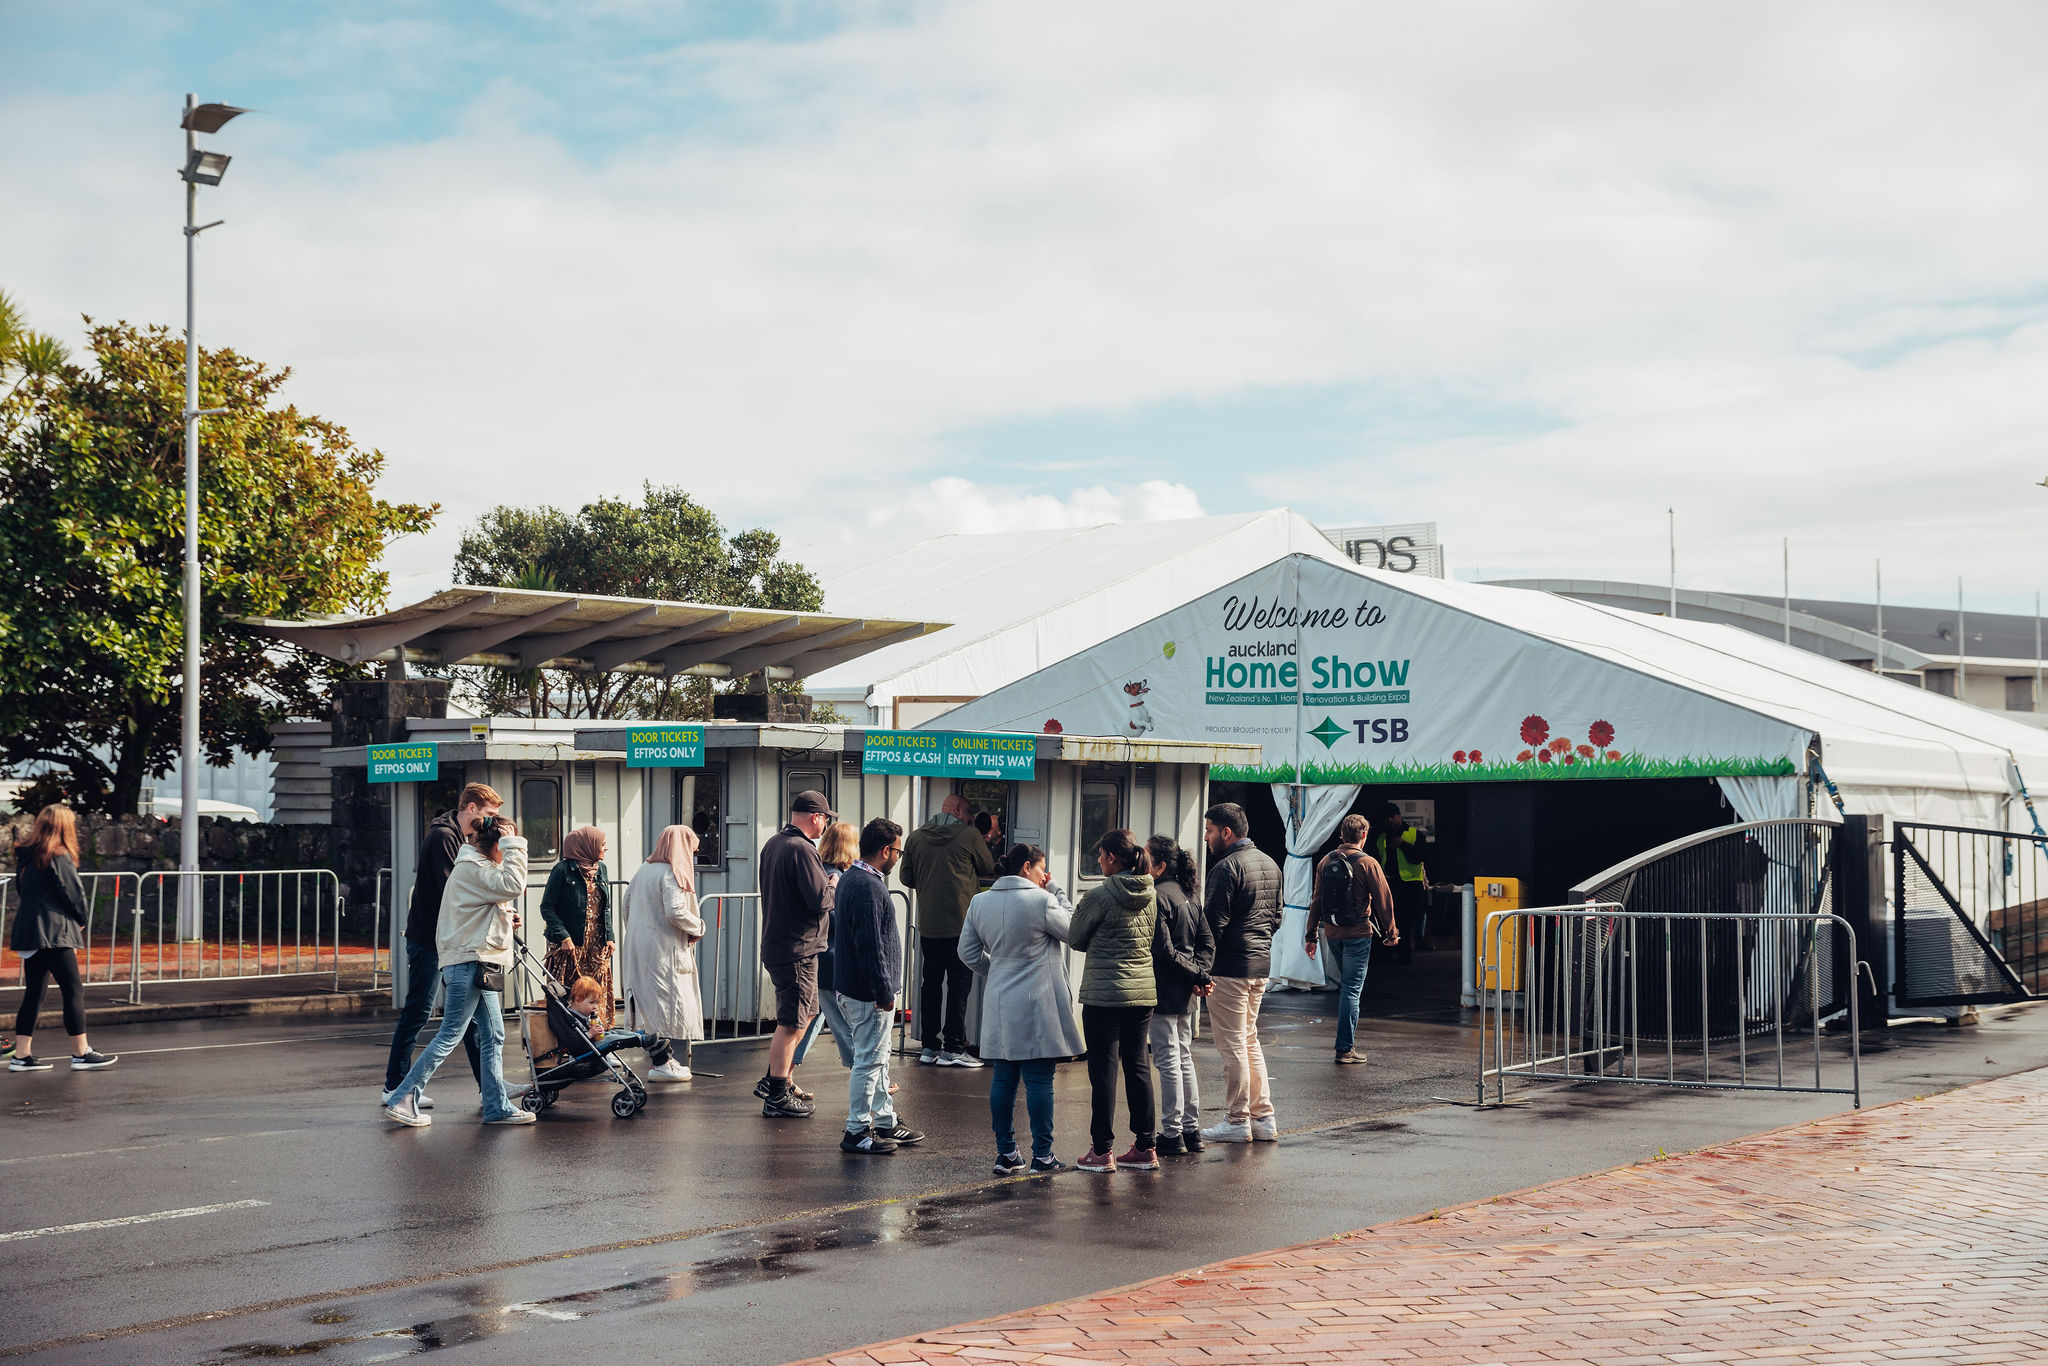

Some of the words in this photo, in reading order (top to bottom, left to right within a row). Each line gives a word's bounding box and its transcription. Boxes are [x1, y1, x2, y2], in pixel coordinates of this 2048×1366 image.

[1223, 595, 1349, 631] Welcome
[1355, 599, 1386, 628] to
[1228, 639, 1297, 657] auckland
[1206, 656, 1298, 688] Home
[1311, 655, 1410, 689] Show
[1208, 694, 1225, 702] New
[1226, 694, 1261, 703] Zealand's
[1305, 695, 1348, 703] Renovation
[1349, 694, 1355, 703] &
[1357, 693, 1387, 703] Building
[1388, 692, 1407, 702] Expo
[631, 732, 659, 743] DOOR
[660, 731, 699, 743] TICKETS
[1233, 726, 1261, 734] BROUGHT
[1353, 718, 1409, 743] TSB
[867, 735, 895, 747] DOOR
[897, 736, 937, 748] TICKETS
[952, 737, 989, 750] ONLINE
[991, 738, 1034, 751] TICKETS
[372, 748, 397, 760] DOOR
[398, 747, 433, 759] TICKETS
[634, 747, 667, 759] EFTPOS
[669, 746, 697, 758] ONLY
[865, 750, 900, 762] EFTPOS
[902, 751, 911, 763] &
[913, 752, 941, 764] CASH
[947, 753, 980, 765] ENTRY
[981, 754, 1005, 767] THIS
[1007, 755, 1033, 767] WAY
[374, 762, 405, 775] EFTPOS
[406, 761, 431, 774] ONLY
